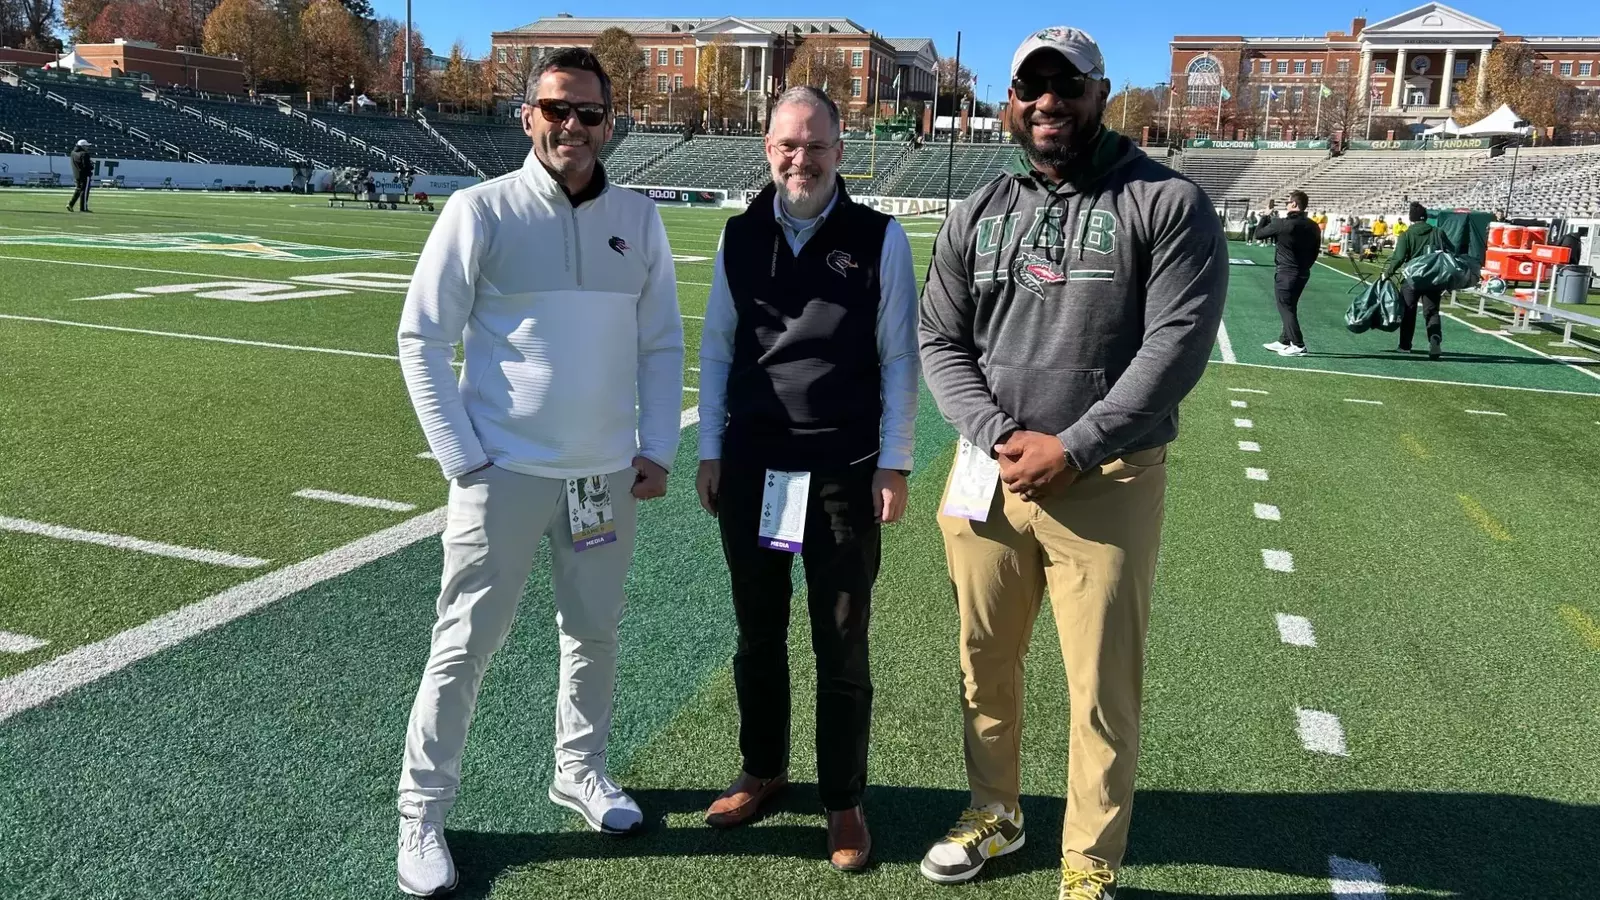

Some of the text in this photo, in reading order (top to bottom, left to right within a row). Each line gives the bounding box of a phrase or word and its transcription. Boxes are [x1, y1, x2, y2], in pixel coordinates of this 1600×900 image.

[1371, 139, 1482, 149] GOLD STANDARD
[649, 190, 676, 199] 90:00
[682, 193, 688, 201] 0
[976, 207, 1117, 256] UAB
[1518, 262, 1533, 275] G
[586, 537, 604, 546] MEDIA
[770, 540, 789, 549] MEDIA
